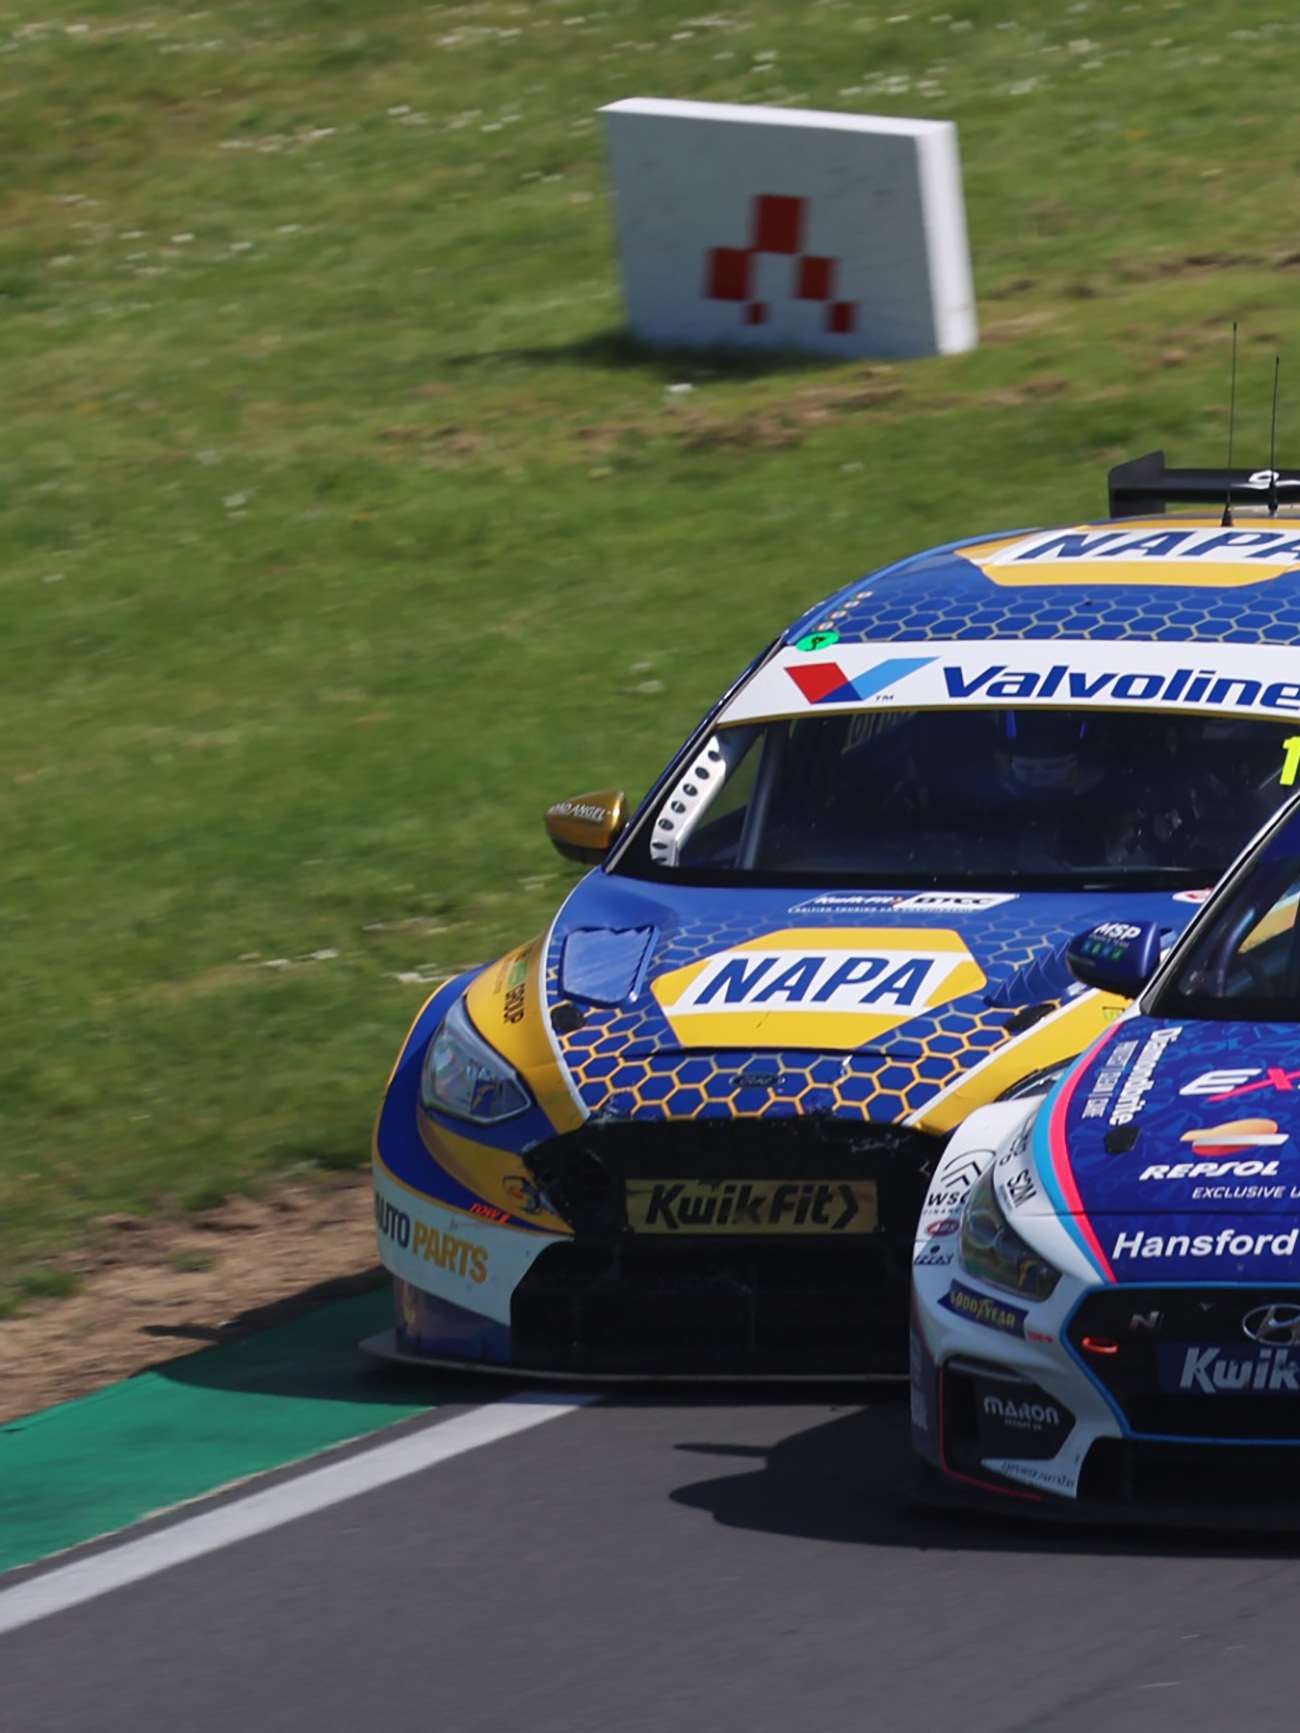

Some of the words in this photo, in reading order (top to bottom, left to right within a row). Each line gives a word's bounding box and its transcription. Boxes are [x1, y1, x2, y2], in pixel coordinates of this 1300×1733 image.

[1092, 922, 1141, 941] MSP
[693, 956, 935, 1006] NAPA
[1138, 1161, 1280, 1182] REPSOL
[1191, 1185, 1286, 1200] EXCLUSIVE
[413, 1219, 489, 1284] PARTS
[1111, 1228, 1300, 1261] Hansford
[1179, 1347, 1300, 1394] Kwik
